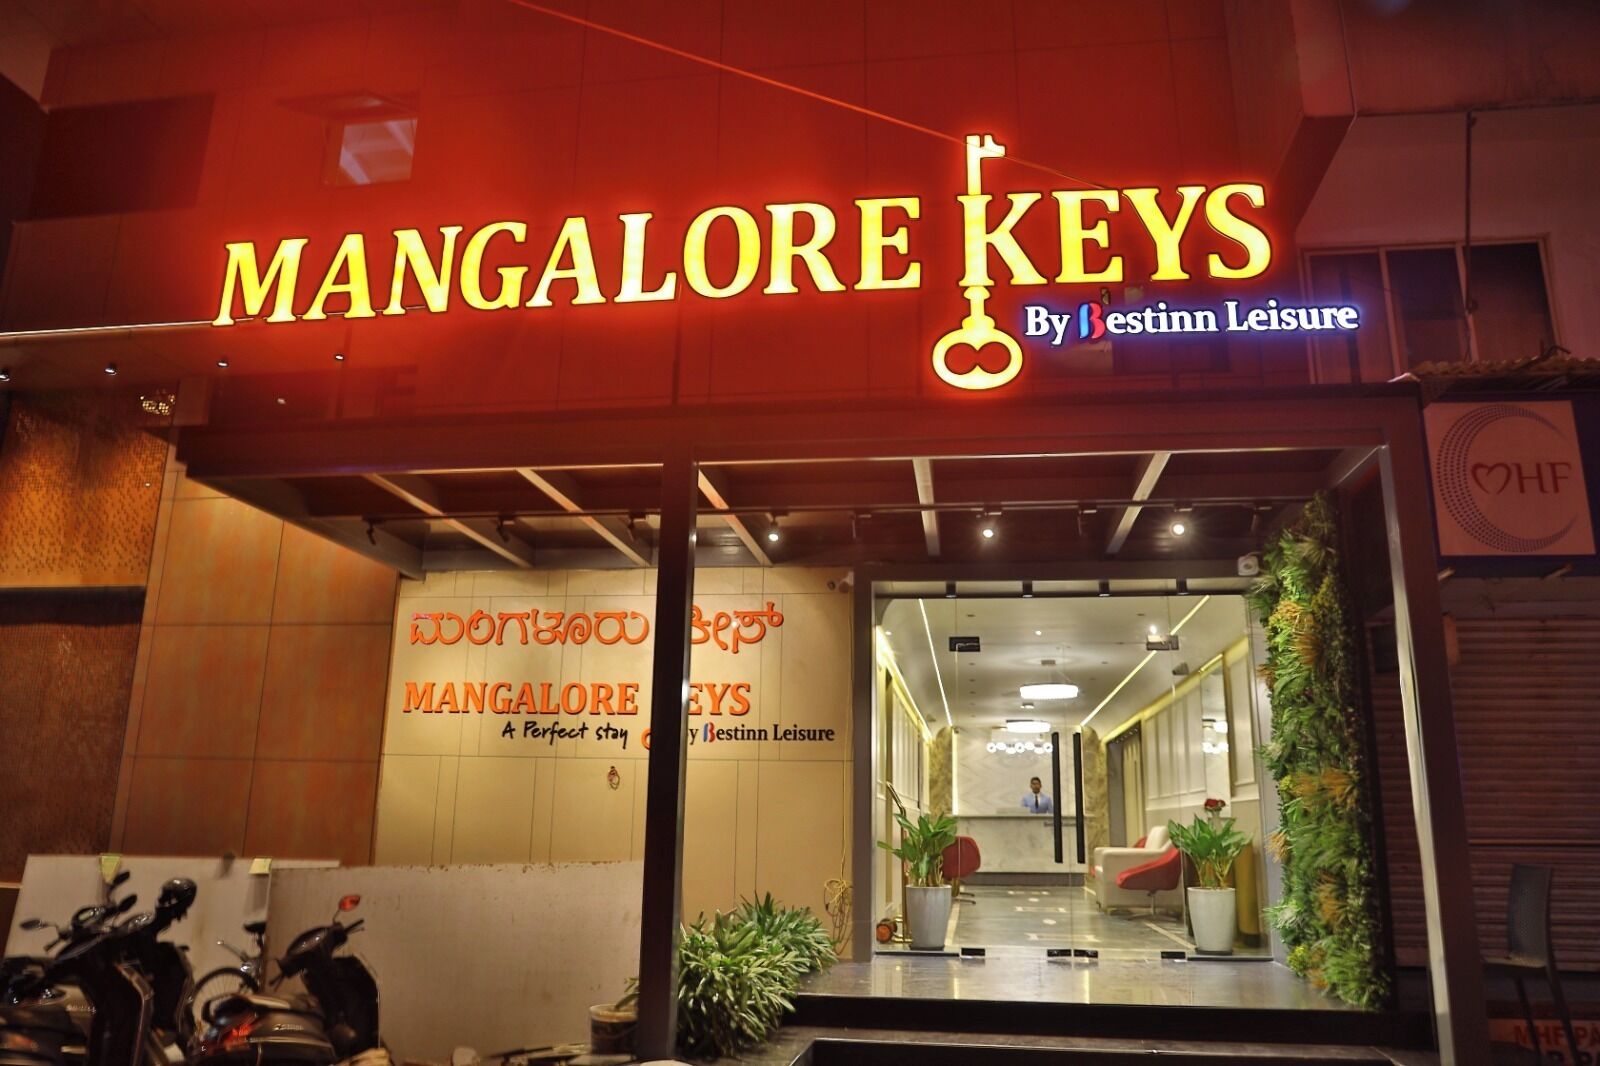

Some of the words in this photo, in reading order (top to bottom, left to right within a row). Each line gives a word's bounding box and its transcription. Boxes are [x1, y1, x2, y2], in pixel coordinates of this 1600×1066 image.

[212, 196, 922, 326] MANGALORE
[957, 183, 1273, 288] KEYS
[1024, 304, 1071, 345] By
[1078, 301, 1219, 340] Bestinn
[1225, 299, 1359, 333] Leisure
[402, 681, 639, 716] MANGALORE
[688, 682, 751, 716] EYS
[501, 721, 516, 740] A
[523, 720, 588, 741] Perfect
[595, 720, 629, 749] stay
[703, 721, 768, 743] Bestinn
[773, 723, 836, 742] Leisure
